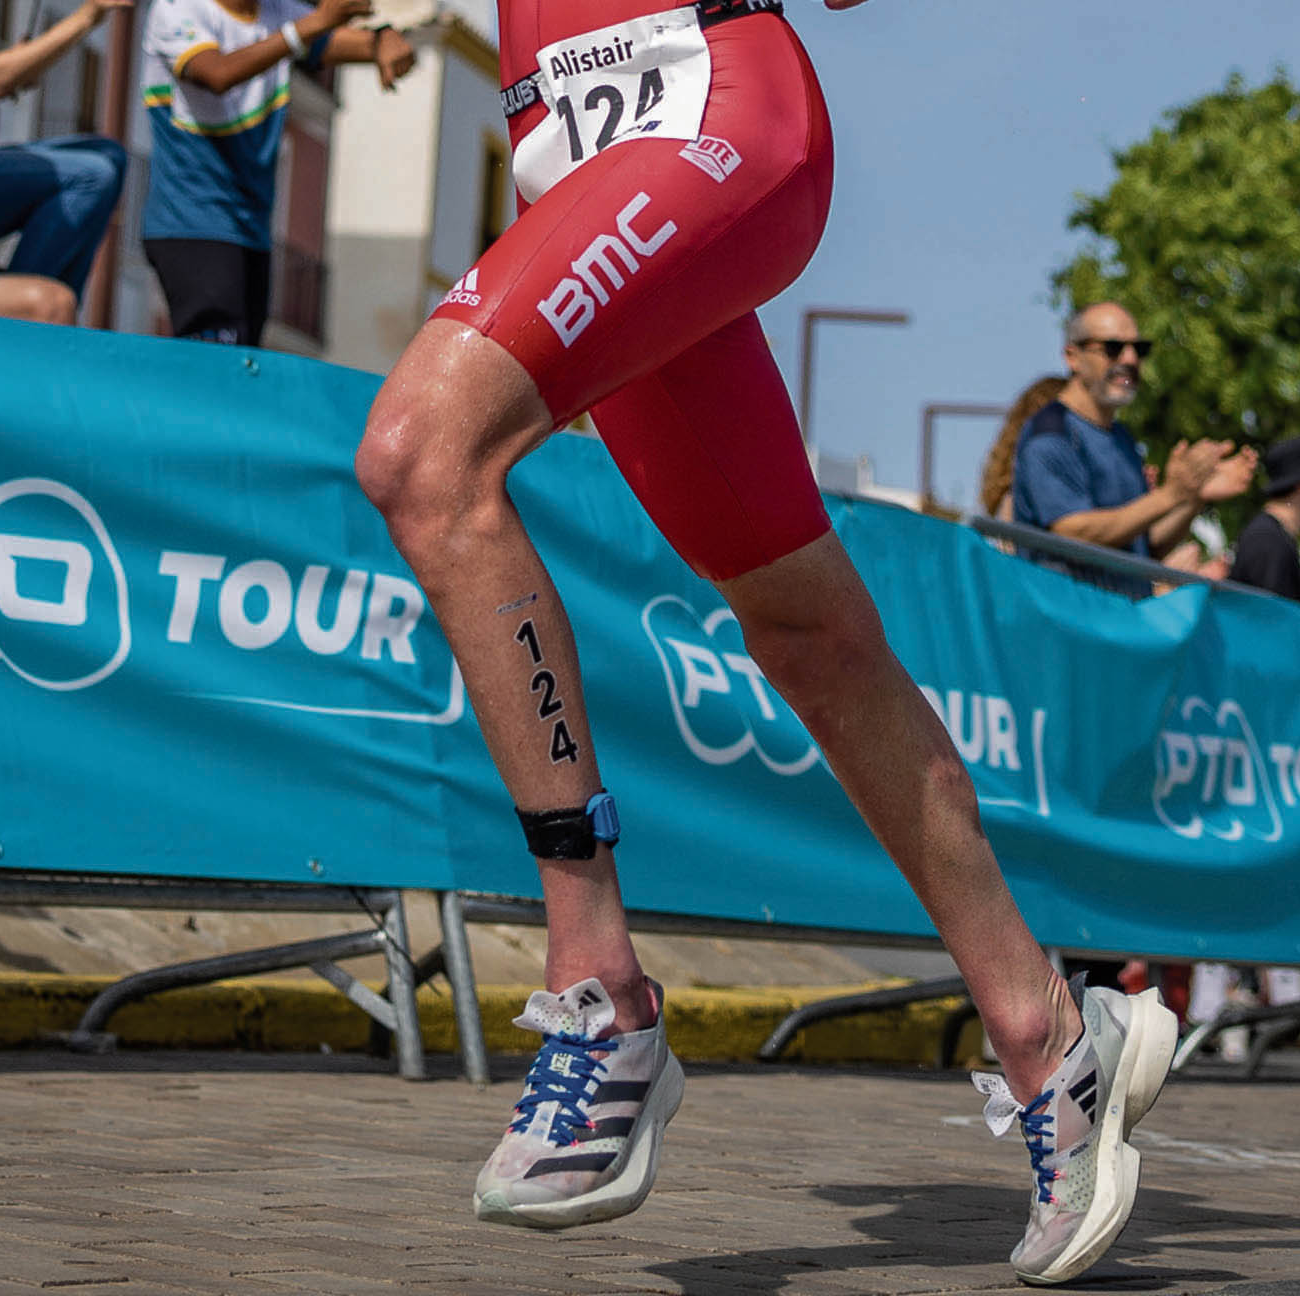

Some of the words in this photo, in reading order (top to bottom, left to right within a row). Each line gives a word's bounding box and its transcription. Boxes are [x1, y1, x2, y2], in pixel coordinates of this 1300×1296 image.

[550, 36, 635, 81] Alistair
[555, 67, 665, 163] 124
[537, 191, 678, 349] BMC
[157, 551, 425, 664] TOUR
[514, 618, 579, 765] 124
[665, 636, 776, 721] PT
